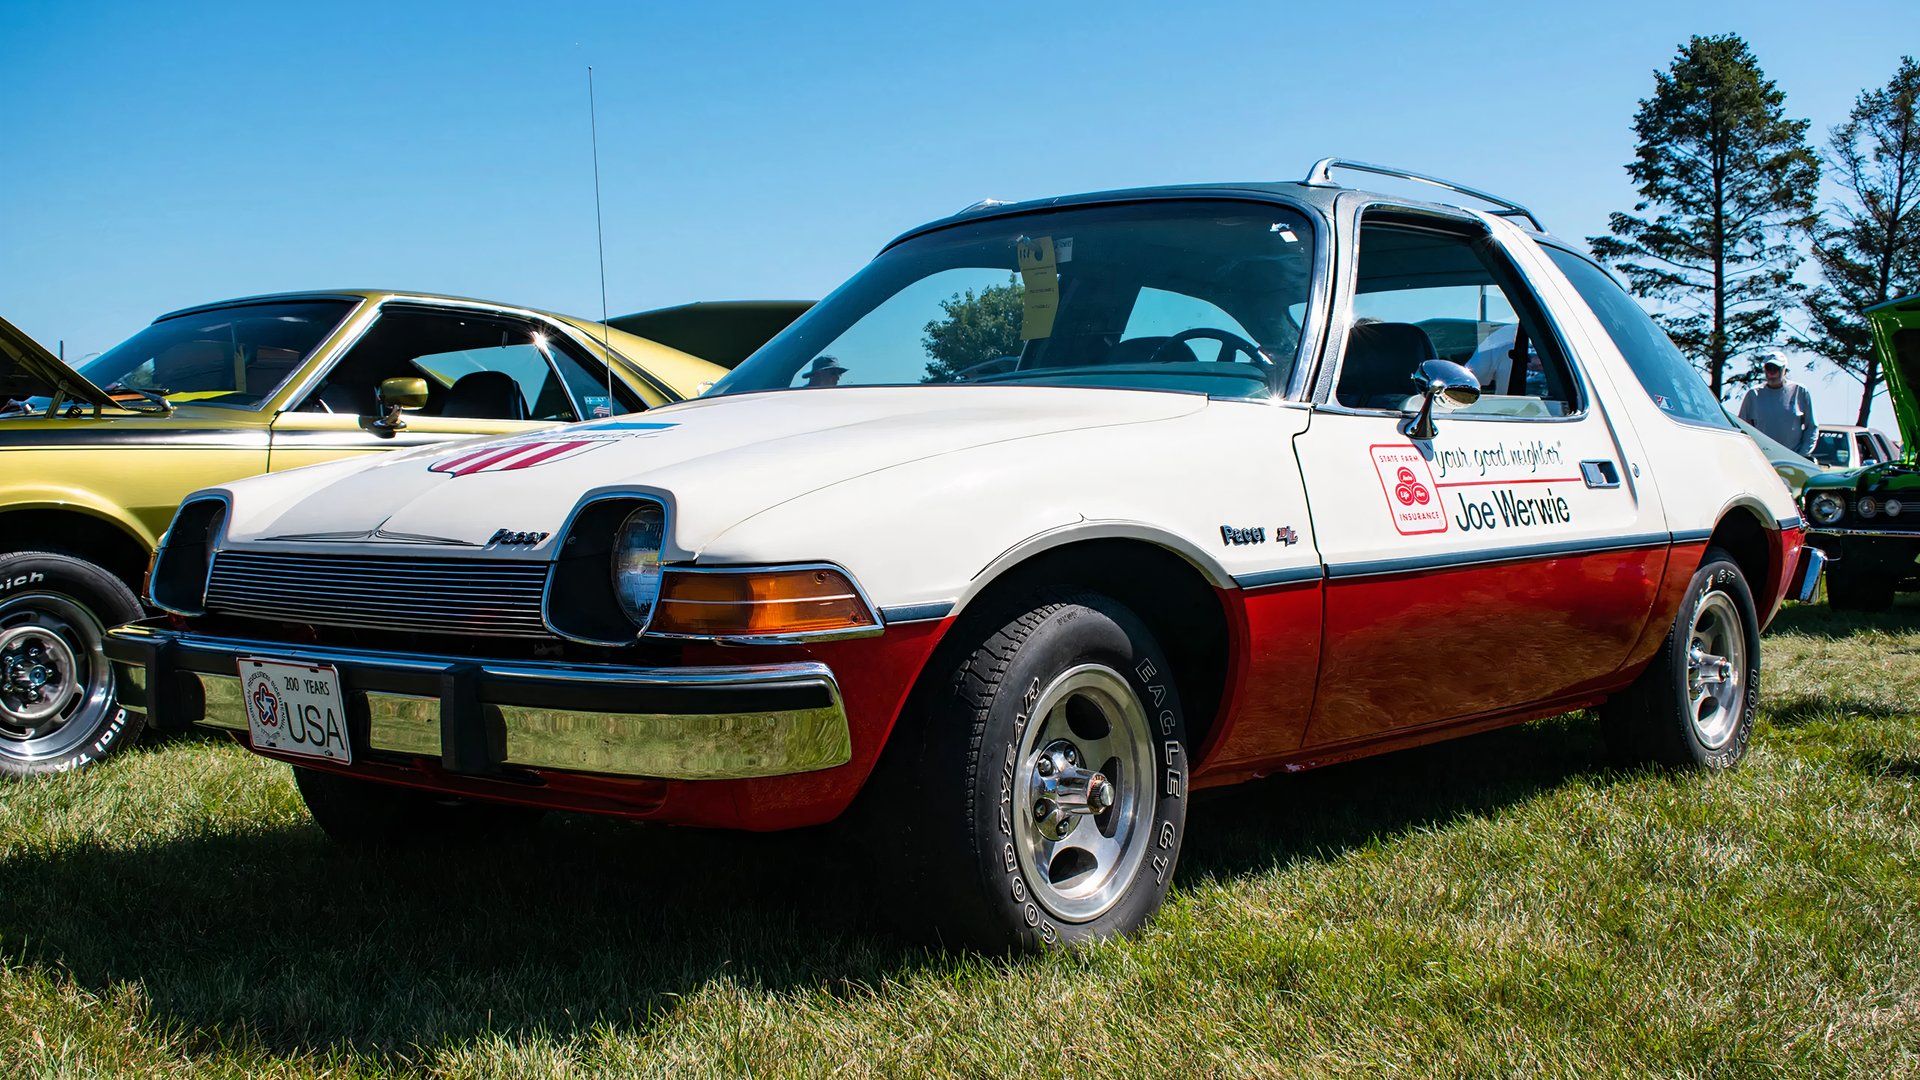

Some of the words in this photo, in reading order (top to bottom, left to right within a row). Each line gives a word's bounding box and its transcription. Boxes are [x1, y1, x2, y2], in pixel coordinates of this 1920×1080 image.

[1379, 455, 1399, 463] STATE
[1474, 442, 1510, 476] good
[1399, 511, 1440, 521] INSURANCE
[1456, 492, 1496, 532] Joe
[1492, 488, 1570, 528] Werwie
[1220, 525, 1265, 546] Pacer
[284, 676, 300, 692] 200
[303, 679, 330, 696] YEARS
[284, 702, 345, 750] USA
[1136, 658, 1182, 798] EAGLE
[1000, 677, 1057, 944] GOODYEAR
[1152, 821, 1175, 885] GT
